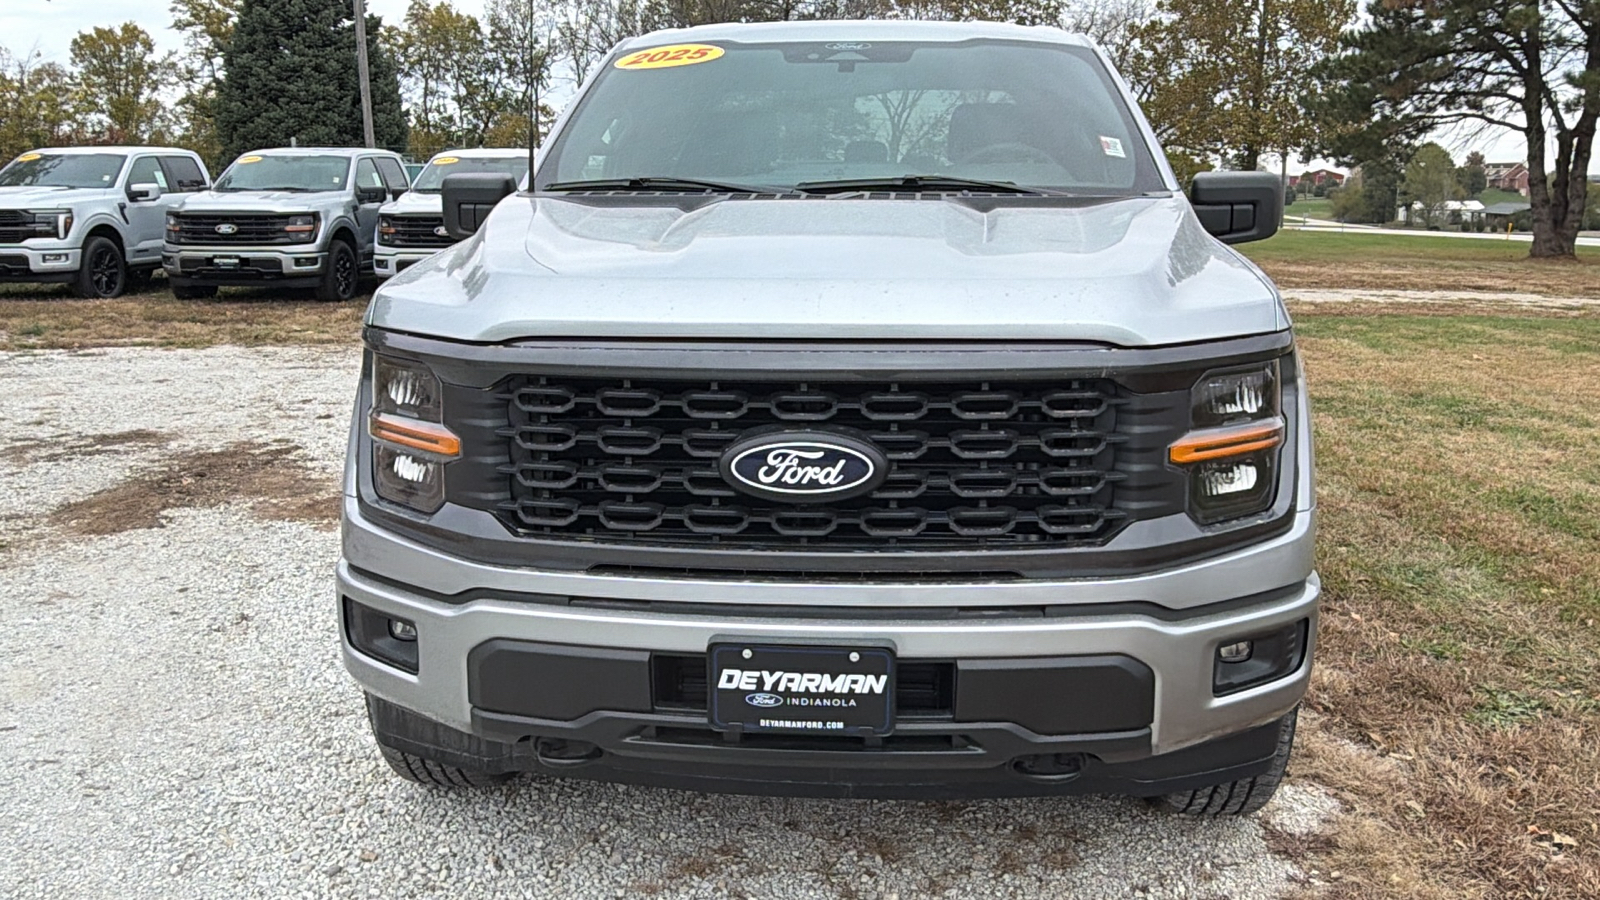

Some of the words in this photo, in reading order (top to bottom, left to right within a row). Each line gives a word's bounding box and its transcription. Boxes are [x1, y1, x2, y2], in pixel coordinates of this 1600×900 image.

[624, 48, 713, 66] 2025
[758, 449, 846, 484] Ford
[718, 669, 887, 694] DEYARMAN
[752, 695, 776, 705] Ford
[787, 697, 857, 707] INDIANOLA
[760, 719, 844, 729] DEYARMANFORD.COM
